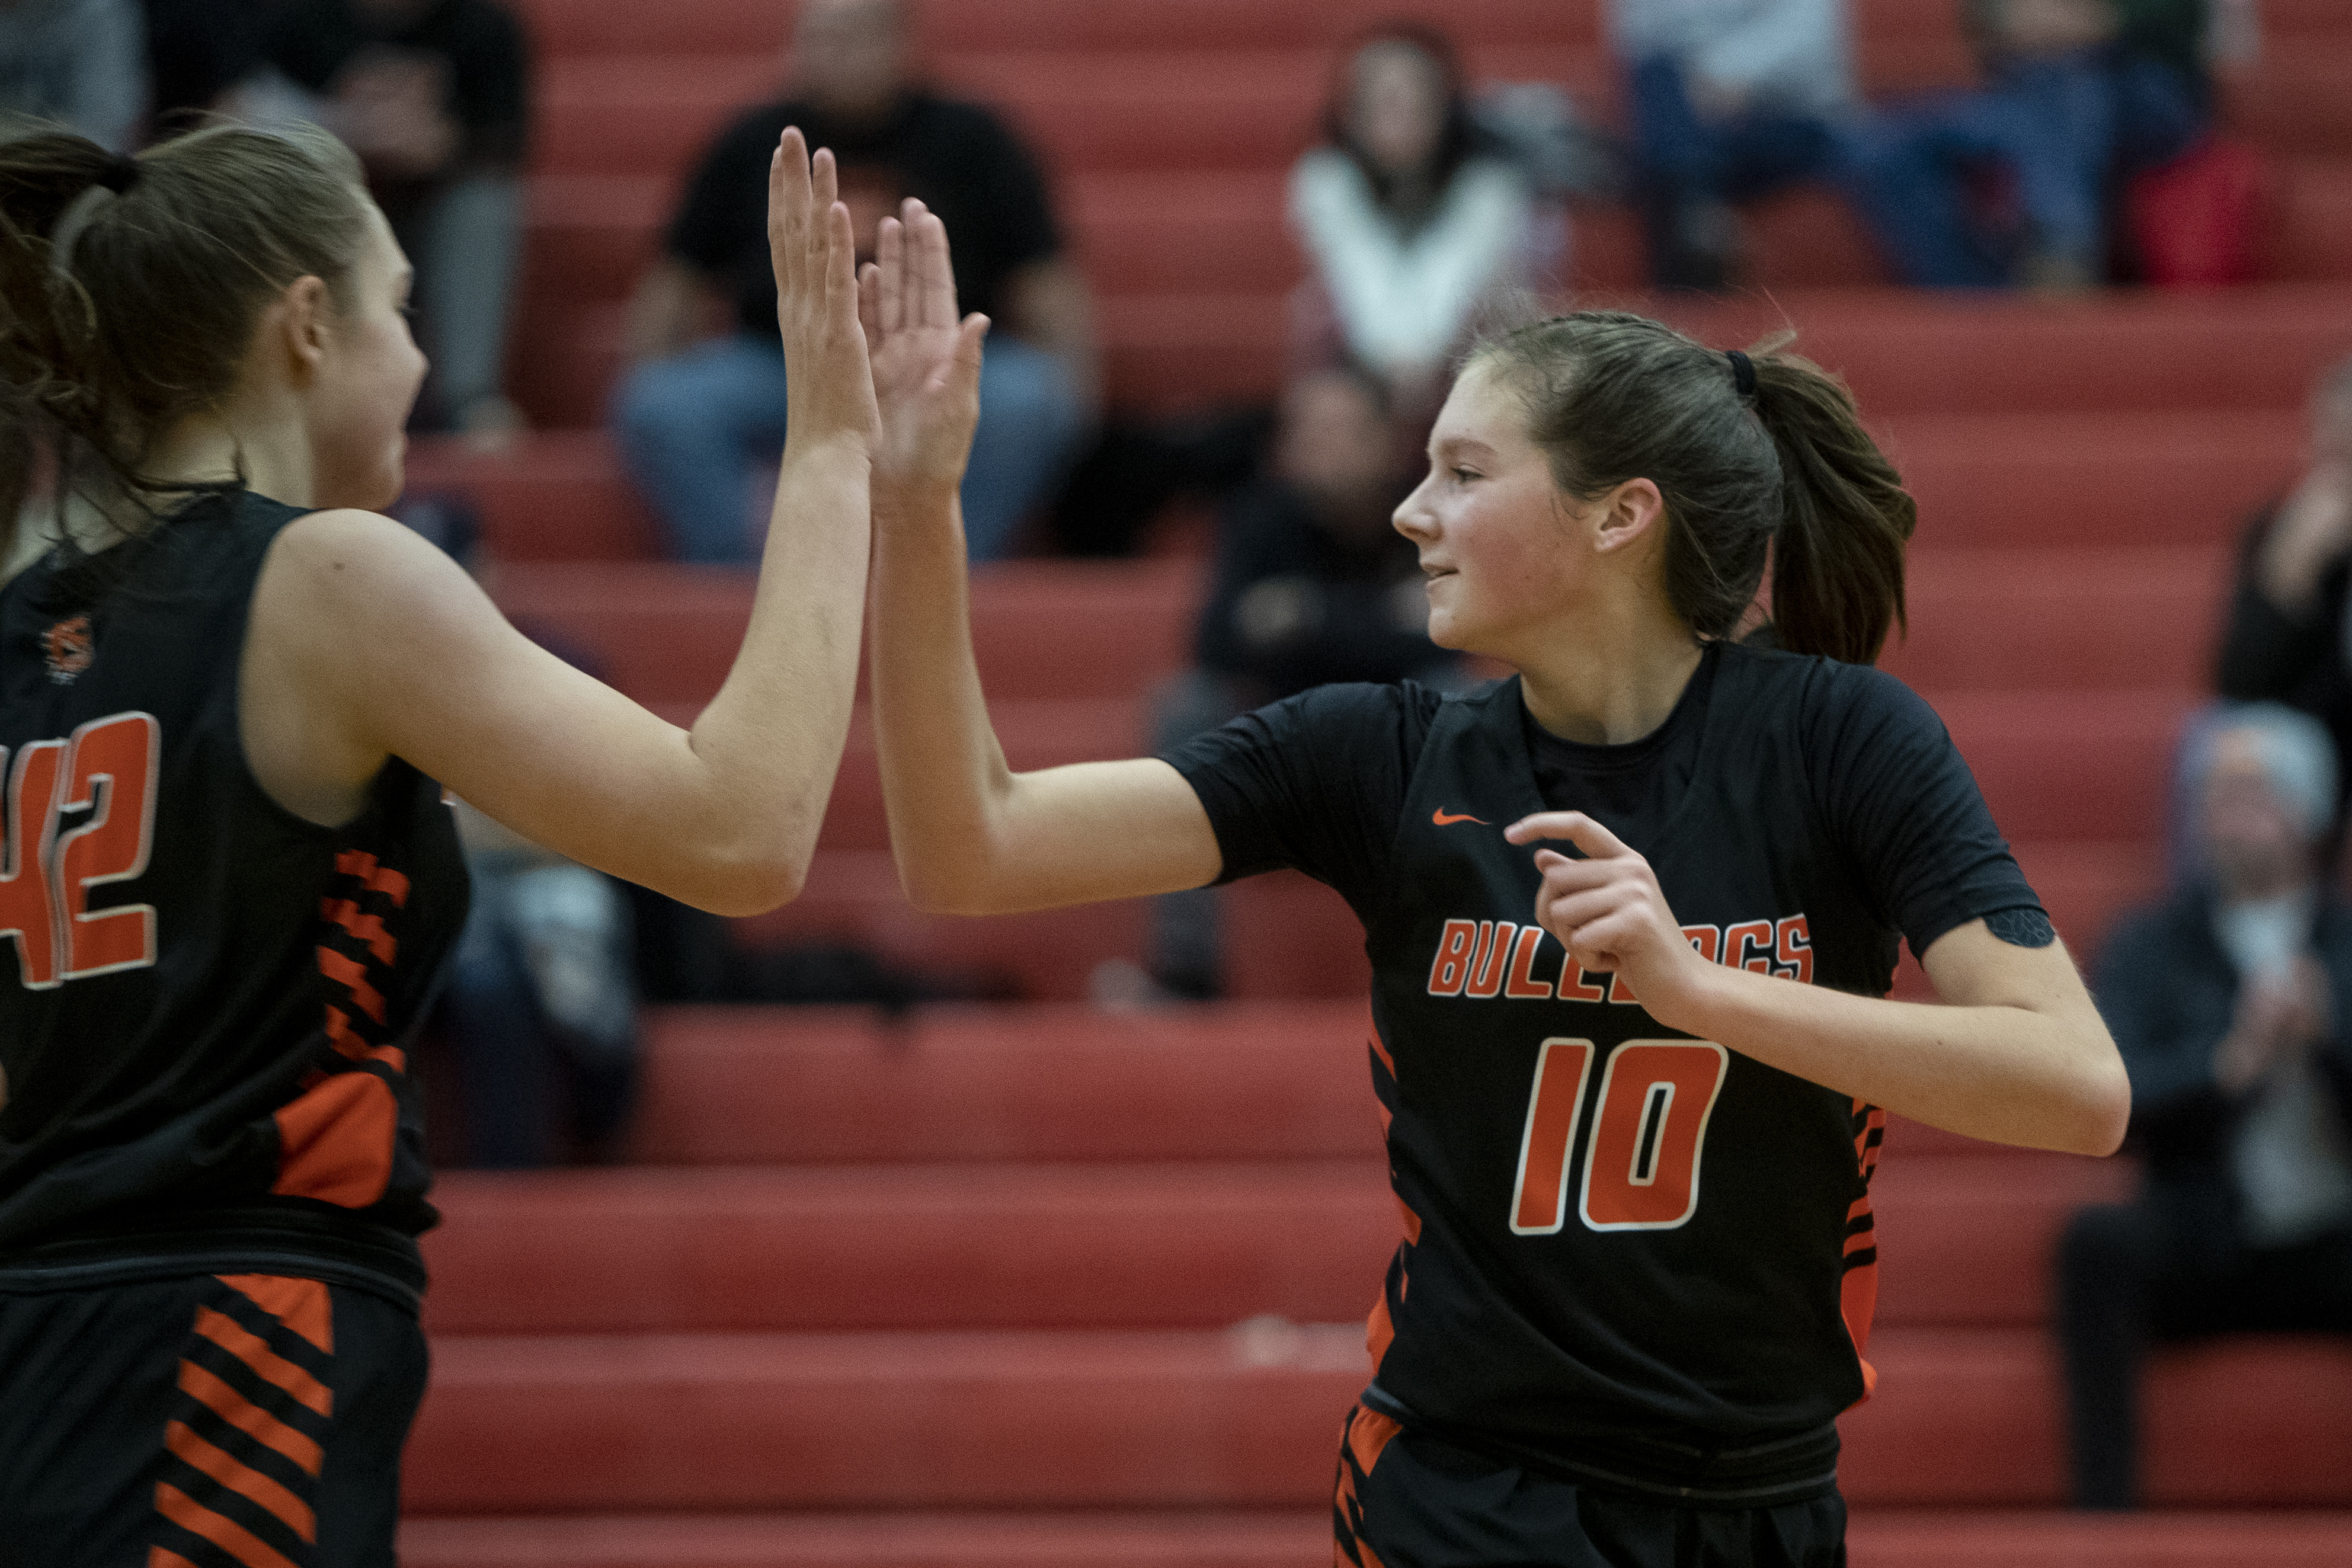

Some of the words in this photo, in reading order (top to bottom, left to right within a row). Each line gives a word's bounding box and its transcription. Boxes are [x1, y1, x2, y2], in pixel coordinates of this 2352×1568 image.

[0, 711, 161, 990] 42
[1427, 913, 1813, 1004] BULLGS
[1509, 1037, 1729, 1235] 10
